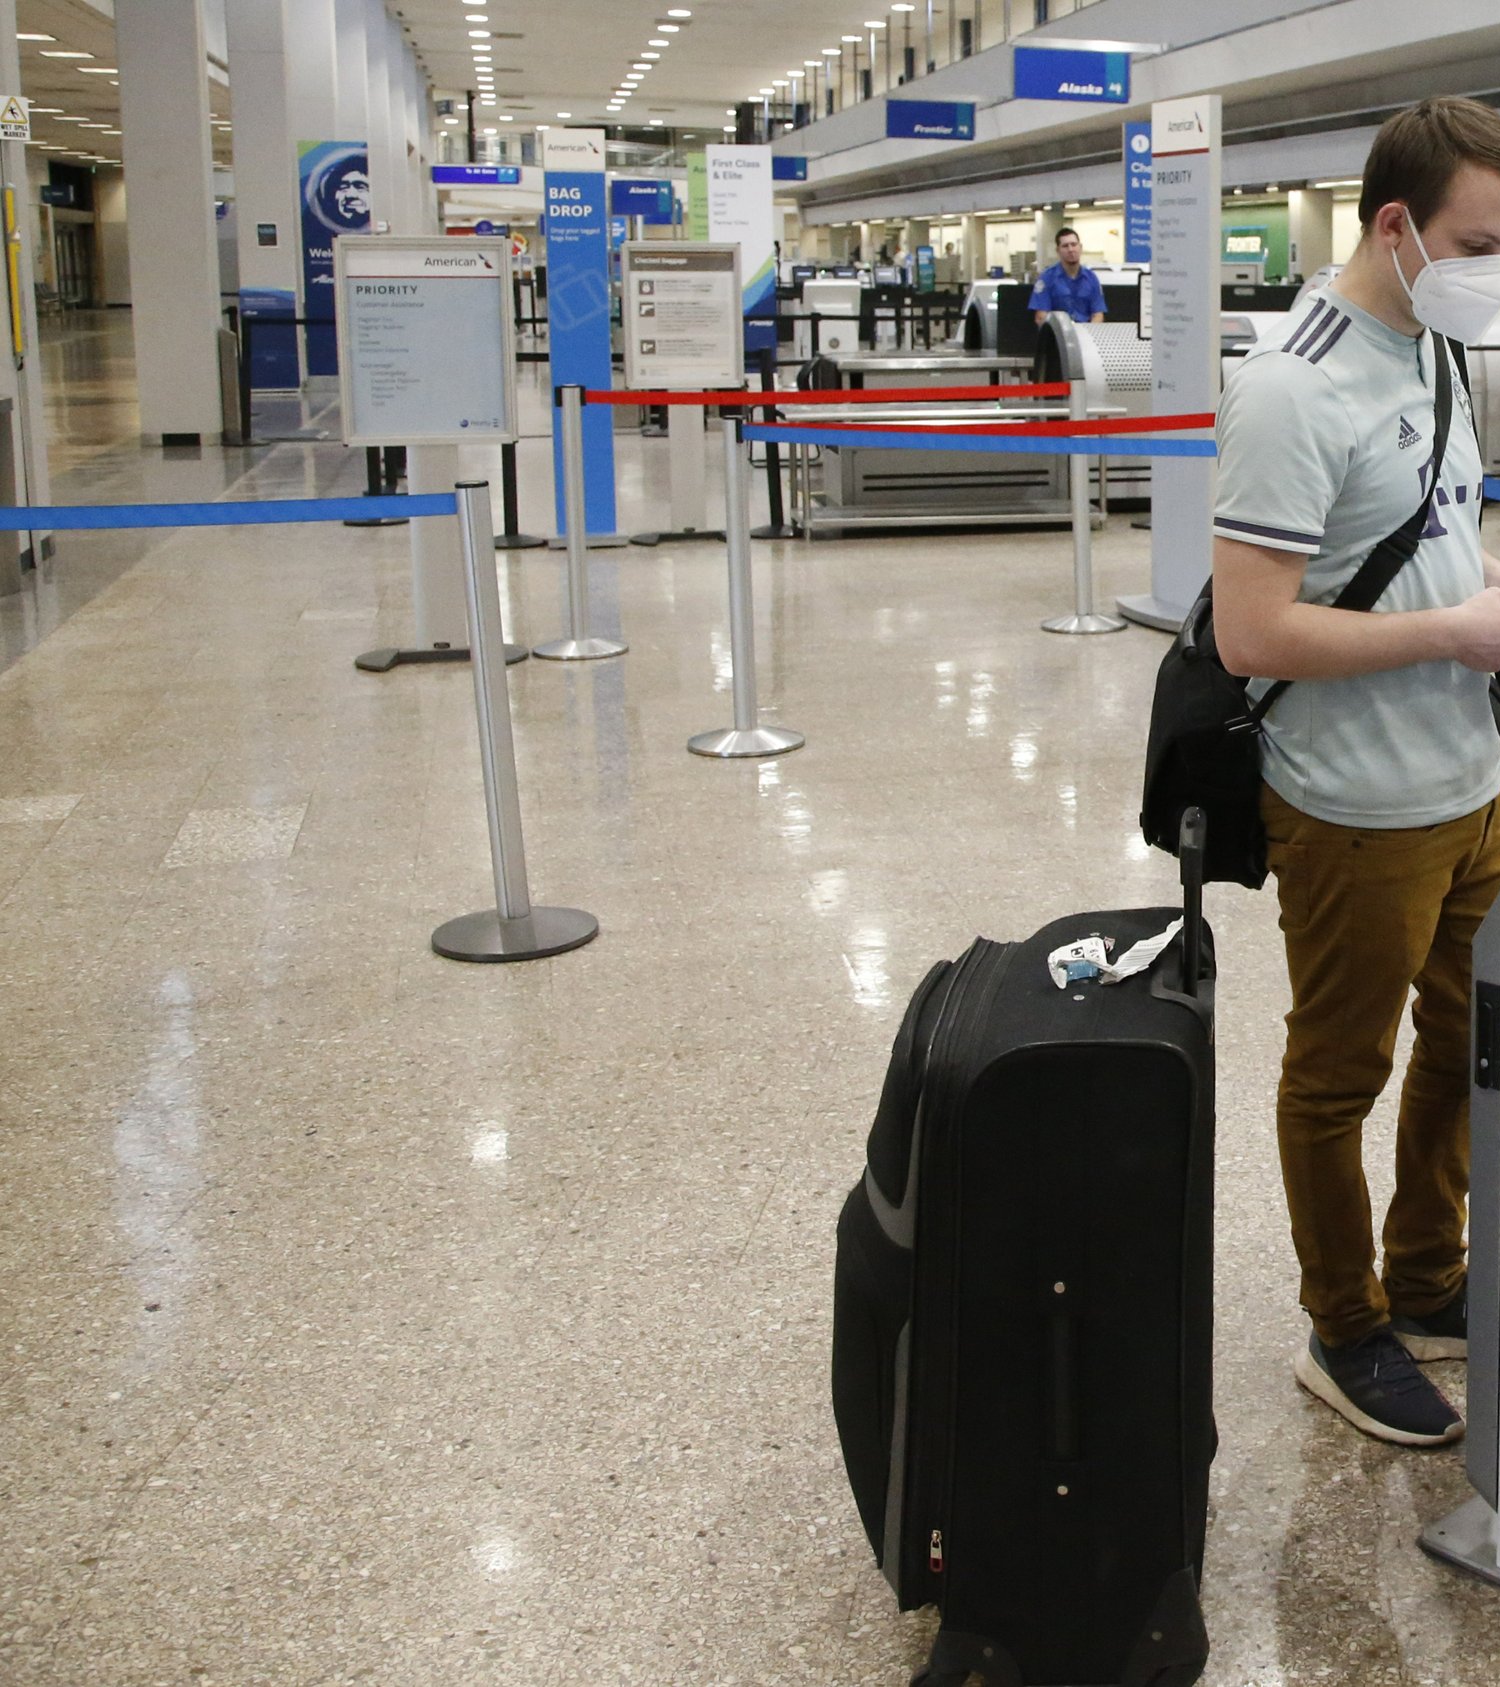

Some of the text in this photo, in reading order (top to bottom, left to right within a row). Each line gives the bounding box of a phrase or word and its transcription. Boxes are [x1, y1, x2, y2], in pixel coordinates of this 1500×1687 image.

[1058, 82, 1103, 95] Alaska
[914, 123, 953, 134] Frontier
[1168, 120, 1194, 133] American
[547, 143, 587, 152] American
[712, 159, 760, 168] First Class
[723, 171, 743, 180] Elite
[1157, 170, 1192, 185] PRIORITY
[549, 187, 581, 200] BAG
[629, 186, 657, 194] Alaska
[549, 205, 592, 217] DROP
[424, 257, 477, 267] American
[356, 285, 418, 295] PRIORITY
[1398, 431, 1422, 450] adidas
